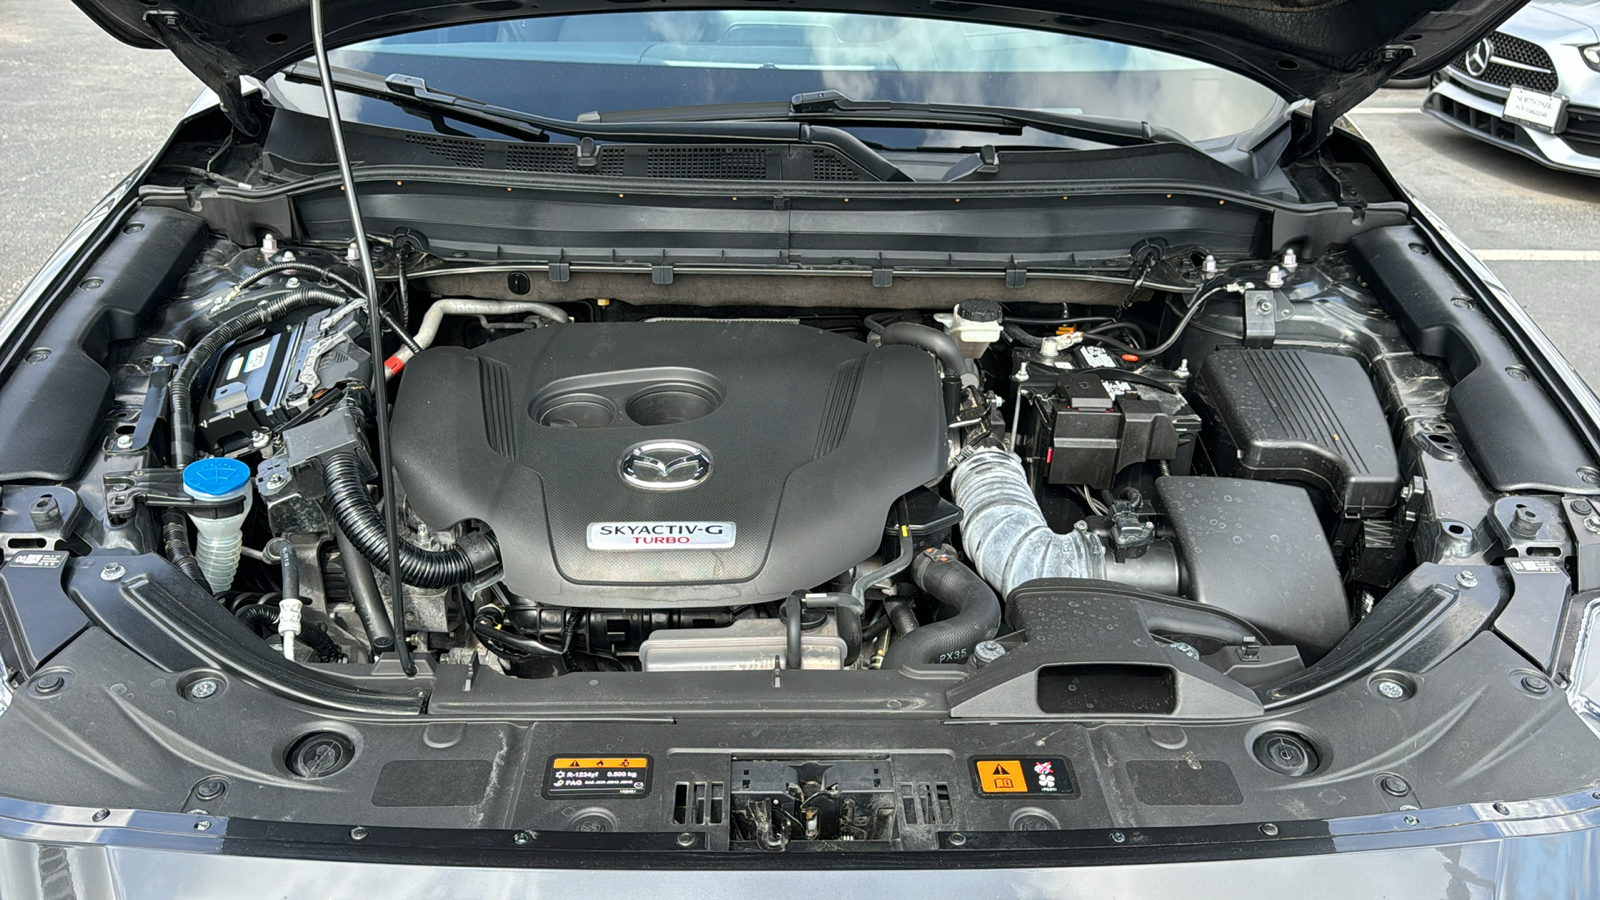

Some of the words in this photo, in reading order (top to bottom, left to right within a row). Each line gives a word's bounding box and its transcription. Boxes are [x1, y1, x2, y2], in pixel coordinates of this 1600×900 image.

[599, 525, 723, 535] SKYACTIV-G
[632, 536, 690, 544] TURBO
[939, 648, 967, 664] PX35
[566, 771, 599, 779] R-1234yf
[627, 771, 637, 779] kg
